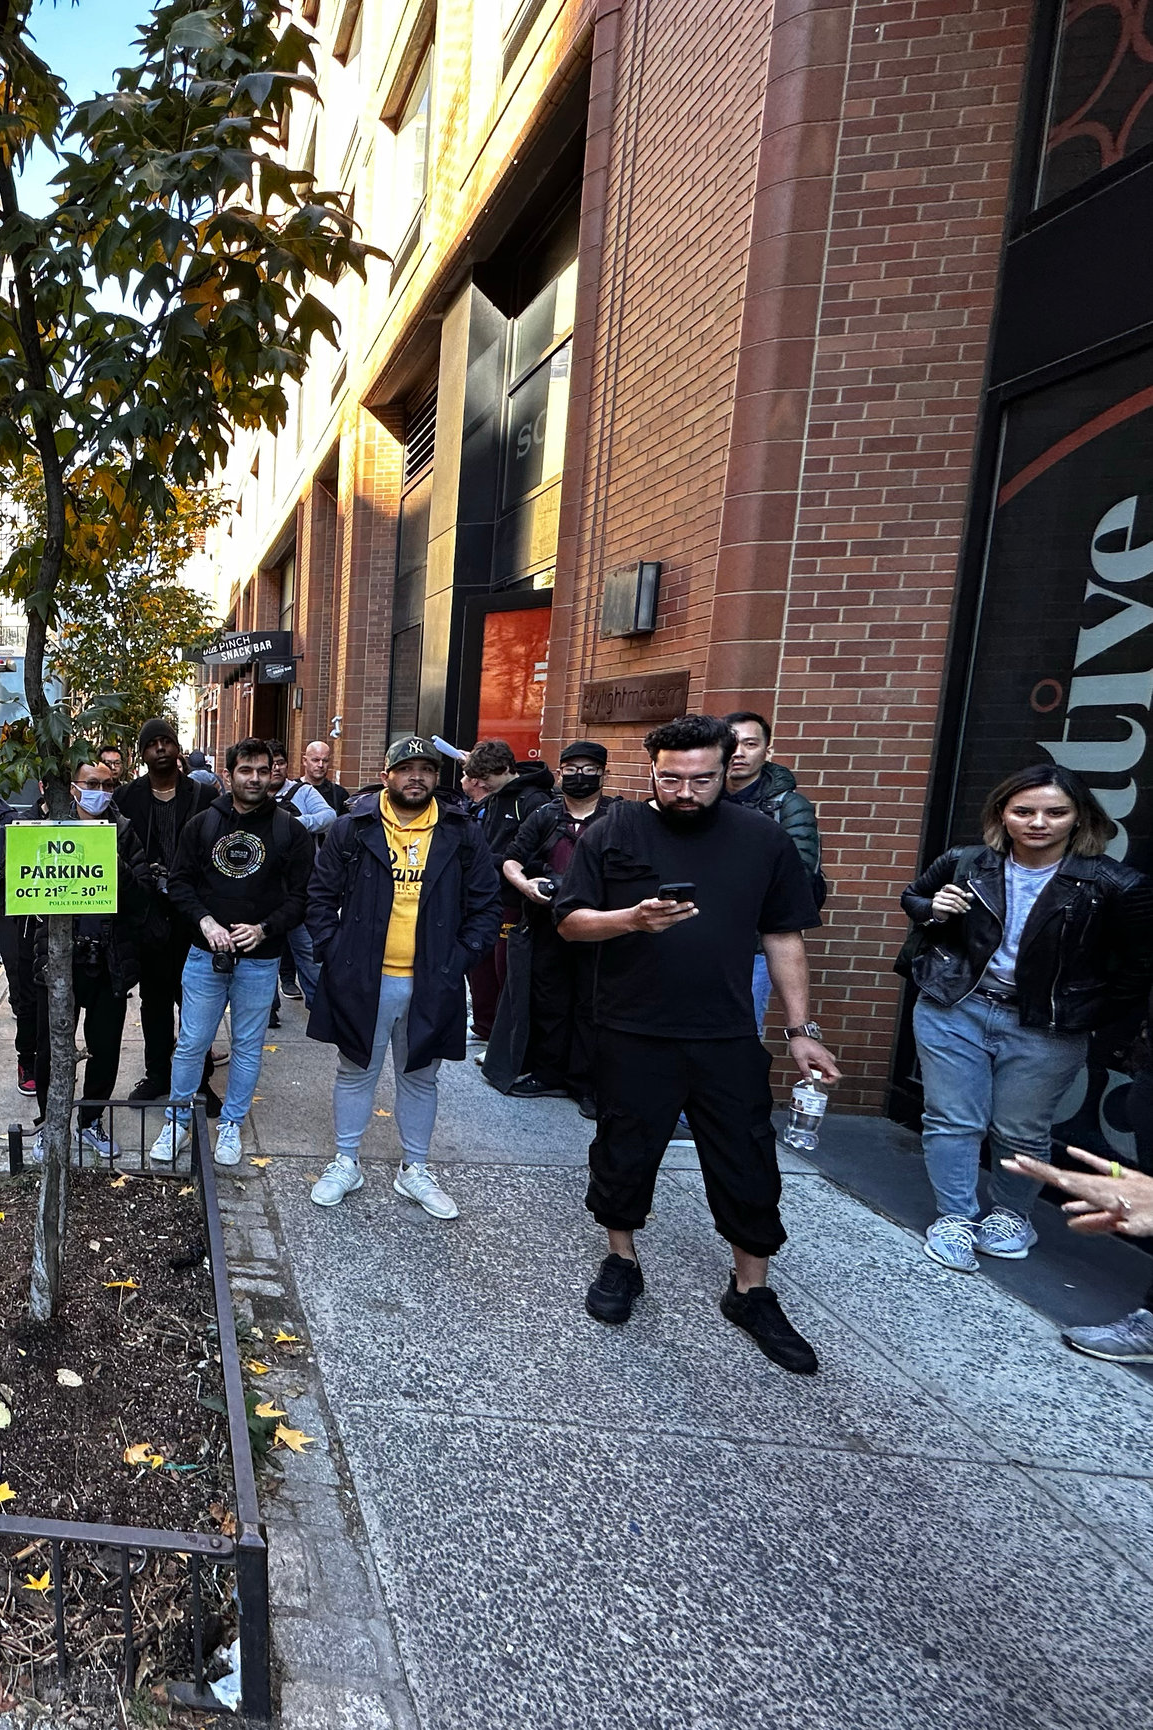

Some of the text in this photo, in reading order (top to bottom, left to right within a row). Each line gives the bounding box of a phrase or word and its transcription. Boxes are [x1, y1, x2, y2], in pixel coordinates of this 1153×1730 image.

[219, 635, 251, 652] PINCH
[220, 640, 273, 662] SNACK BAR
[47, 840, 76, 854] NO
[20, 865, 104, 879] PARKING
[15, 887, 41, 898] OCT
[44, 885, 68, 897] 21ST
[81, 885, 108, 897] 30TH
